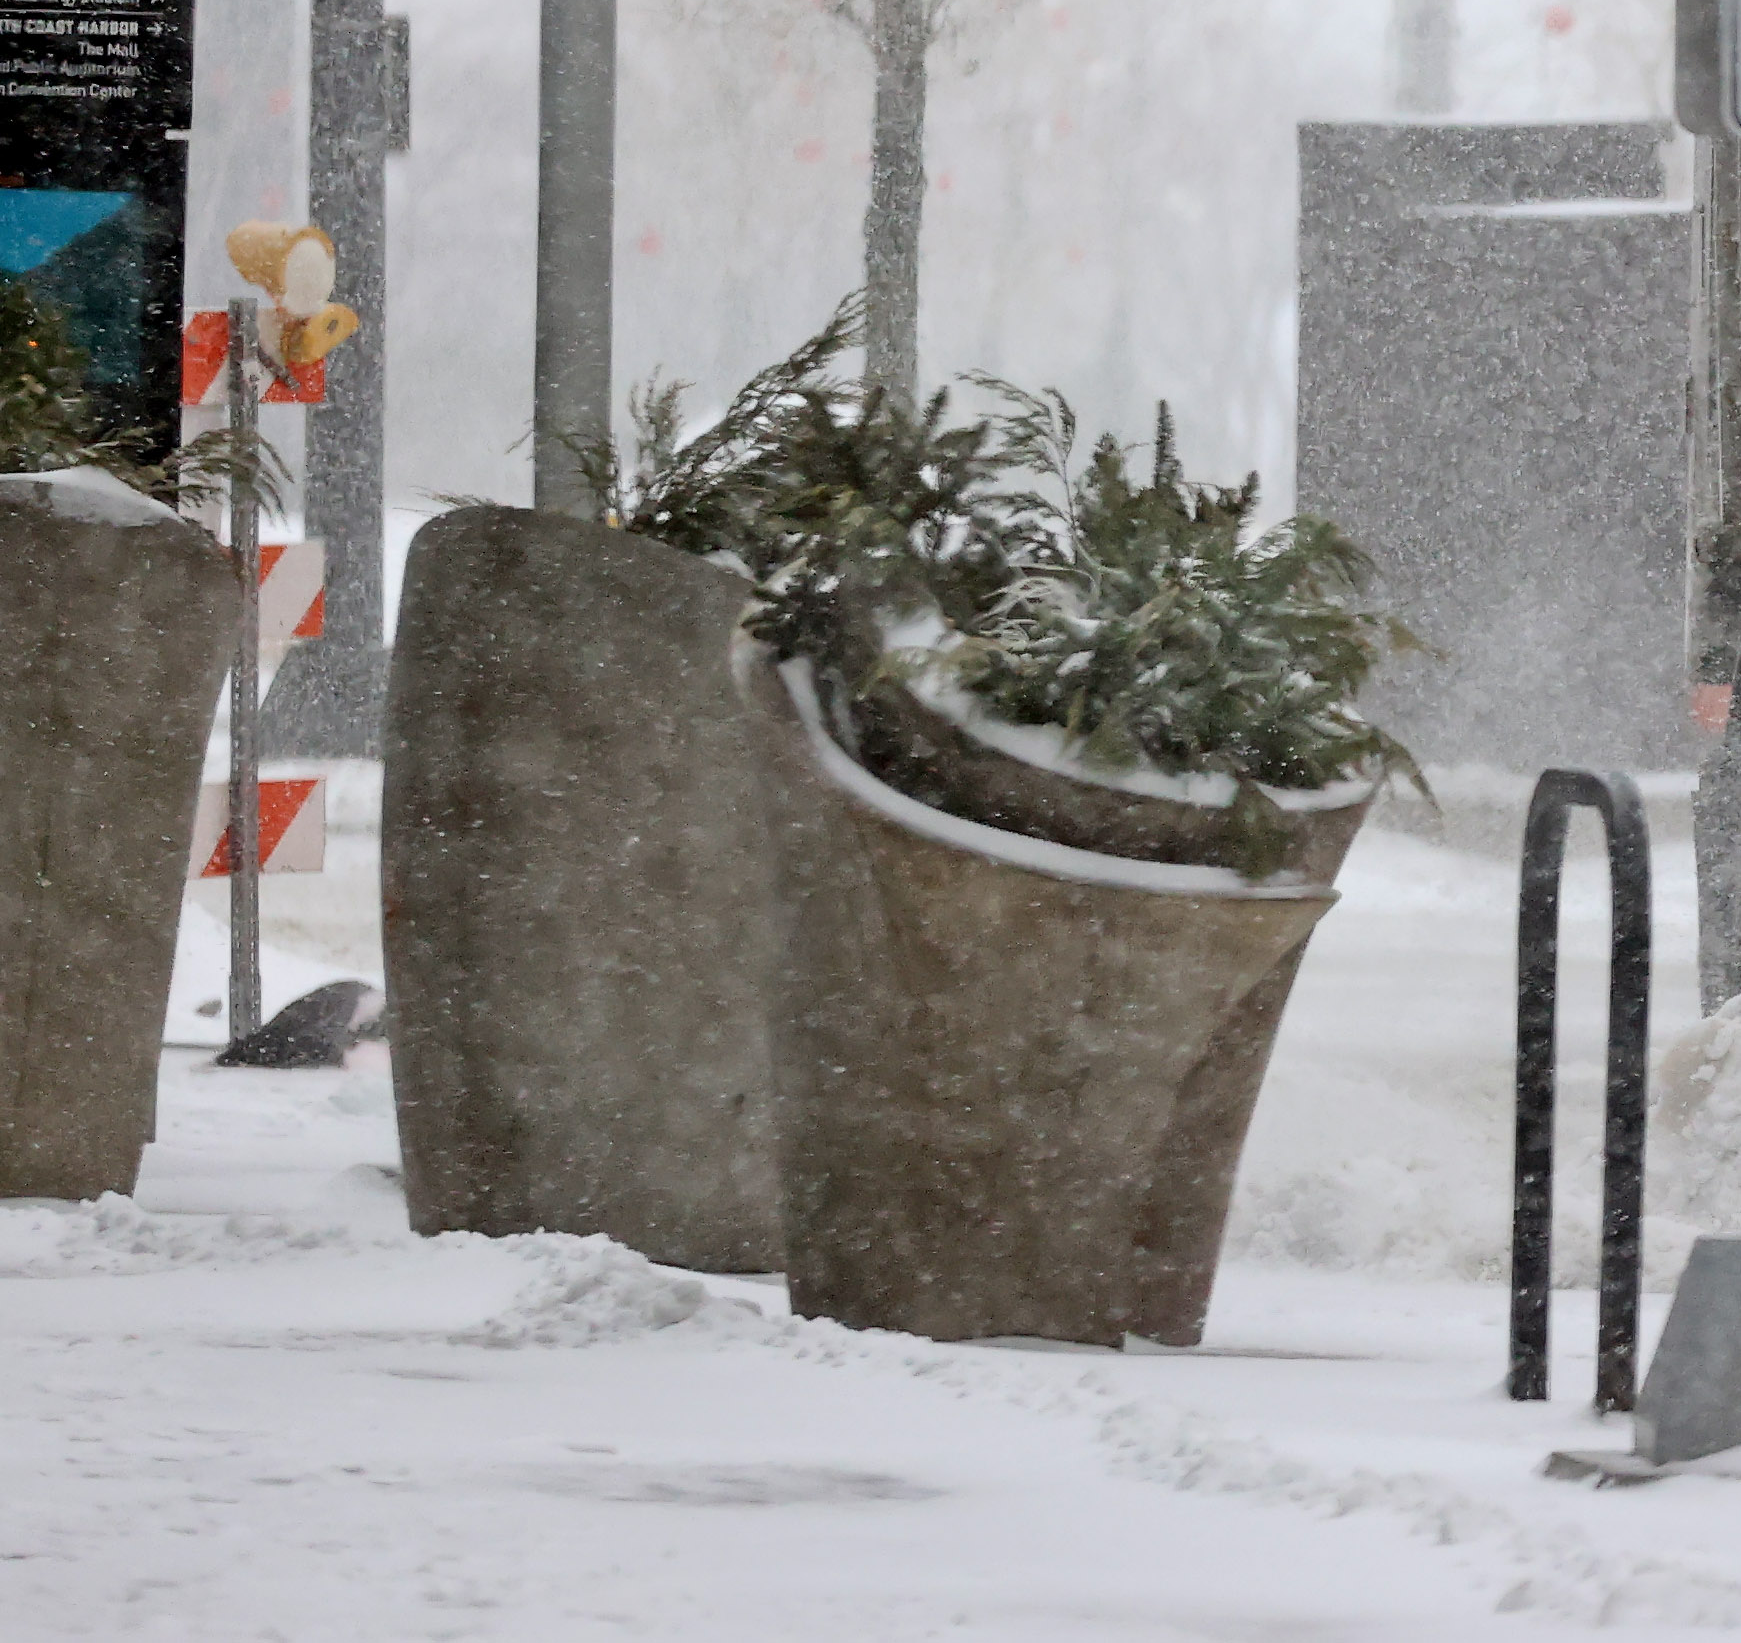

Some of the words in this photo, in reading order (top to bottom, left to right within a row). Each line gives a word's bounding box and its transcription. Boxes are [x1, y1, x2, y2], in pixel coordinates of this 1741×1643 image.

[23, 18, 75, 35] COAST
[77, 20, 139, 36] HARBOR
[78, 41, 104, 56] The
[107, 42, 139, 59] Mall
[90, 83, 138, 98] Center
